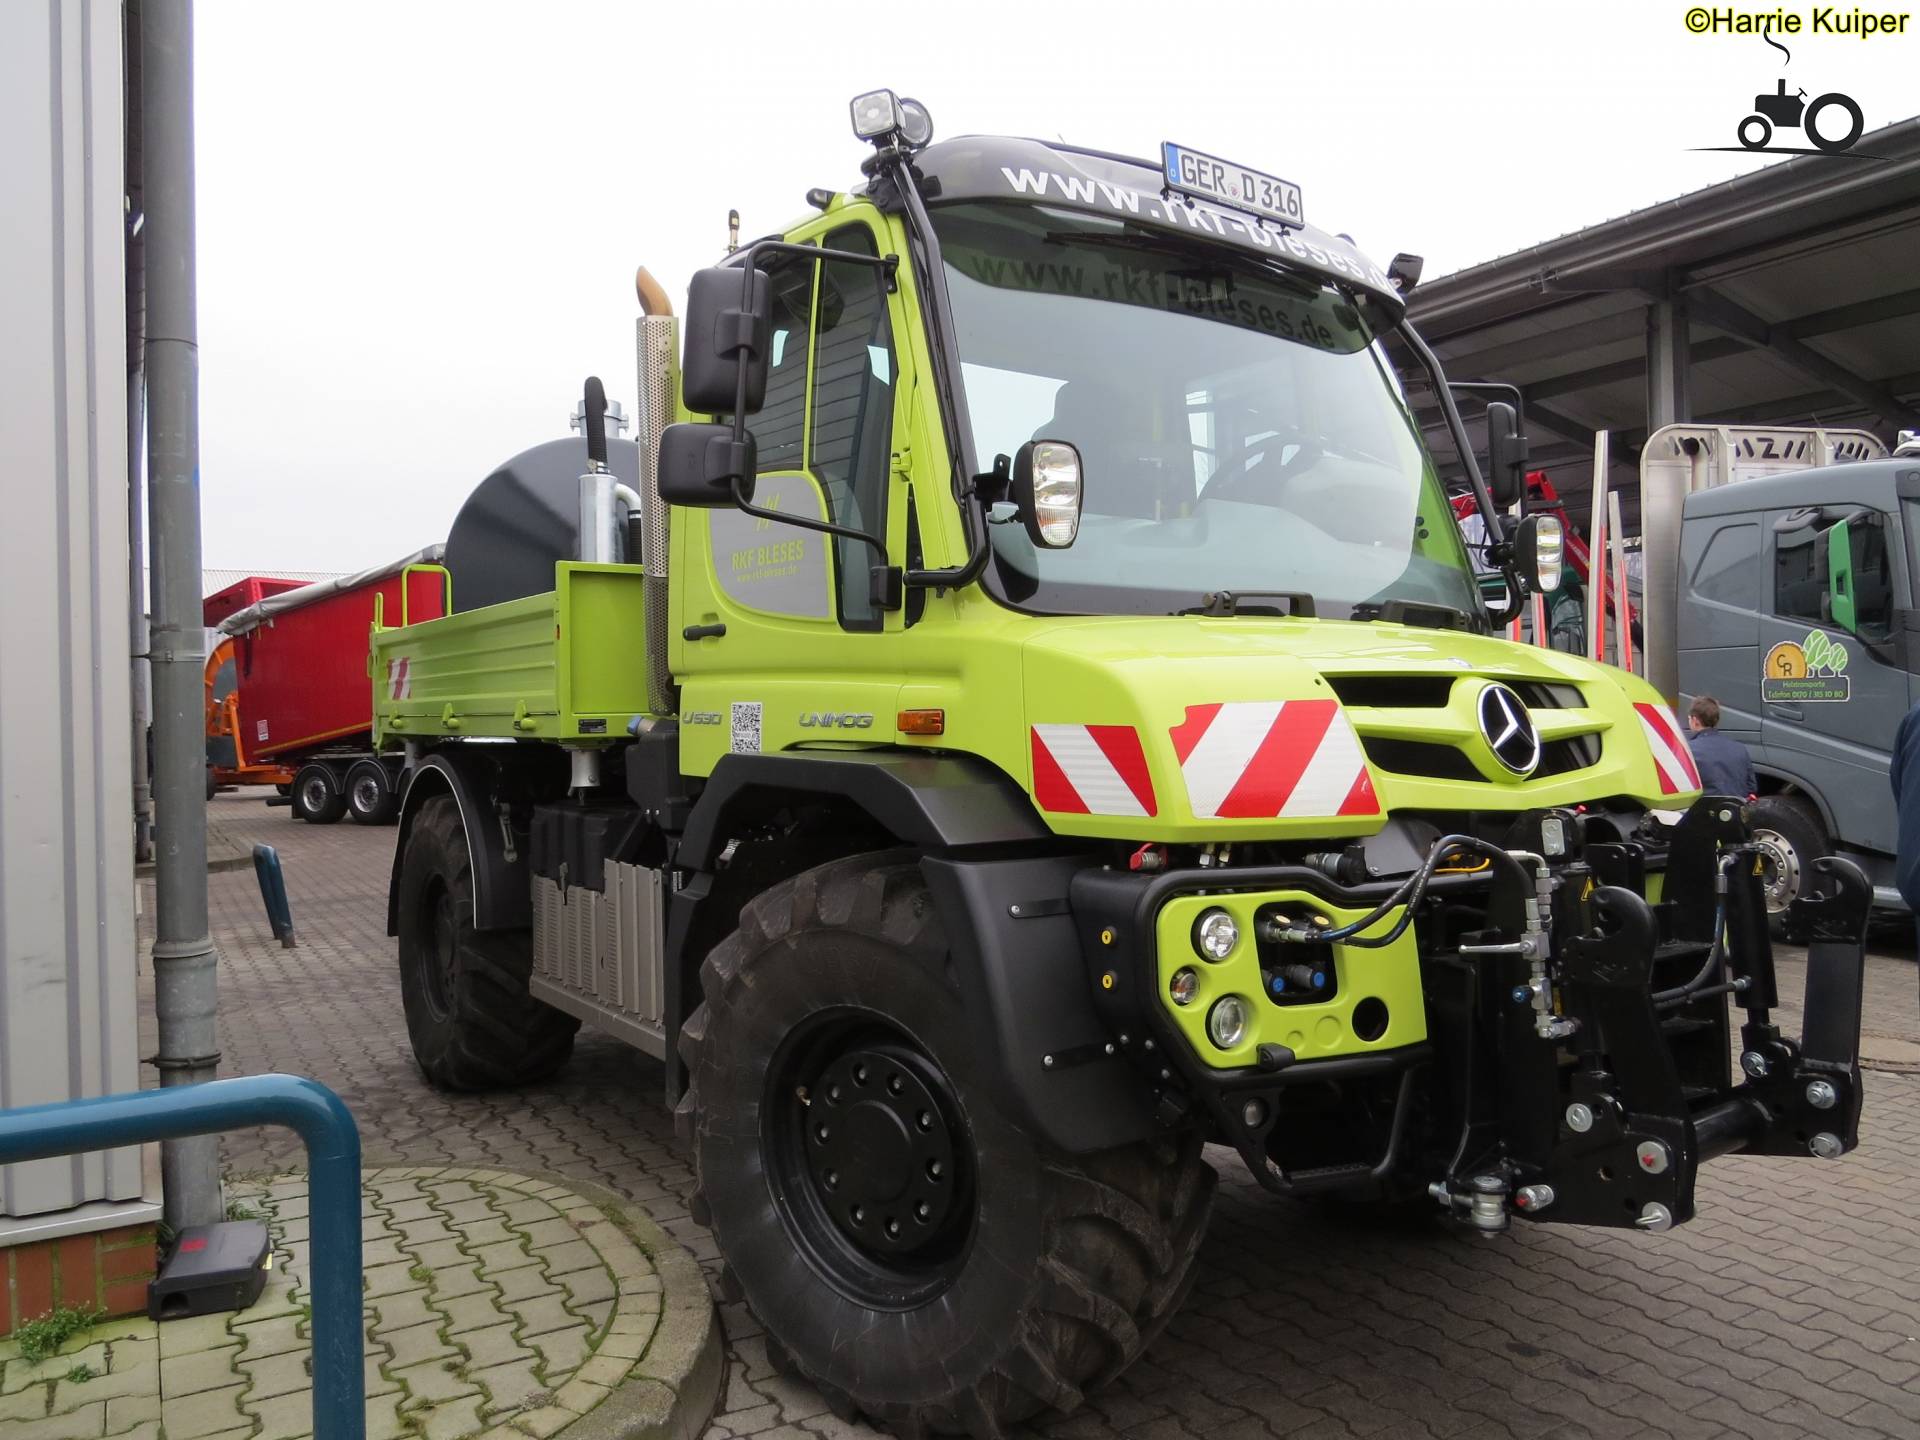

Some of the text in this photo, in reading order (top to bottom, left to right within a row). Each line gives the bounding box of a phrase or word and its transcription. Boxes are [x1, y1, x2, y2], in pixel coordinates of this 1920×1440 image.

[1181, 154, 1227, 195] GER
[1241, 173, 1256, 203] D
[1260, 180, 1298, 216] 316
[1001, 167, 1405, 306] www.rkf-bleses.d
[758, 538, 805, 566] BLESES
[798, 713, 873, 729] UNIMOG
